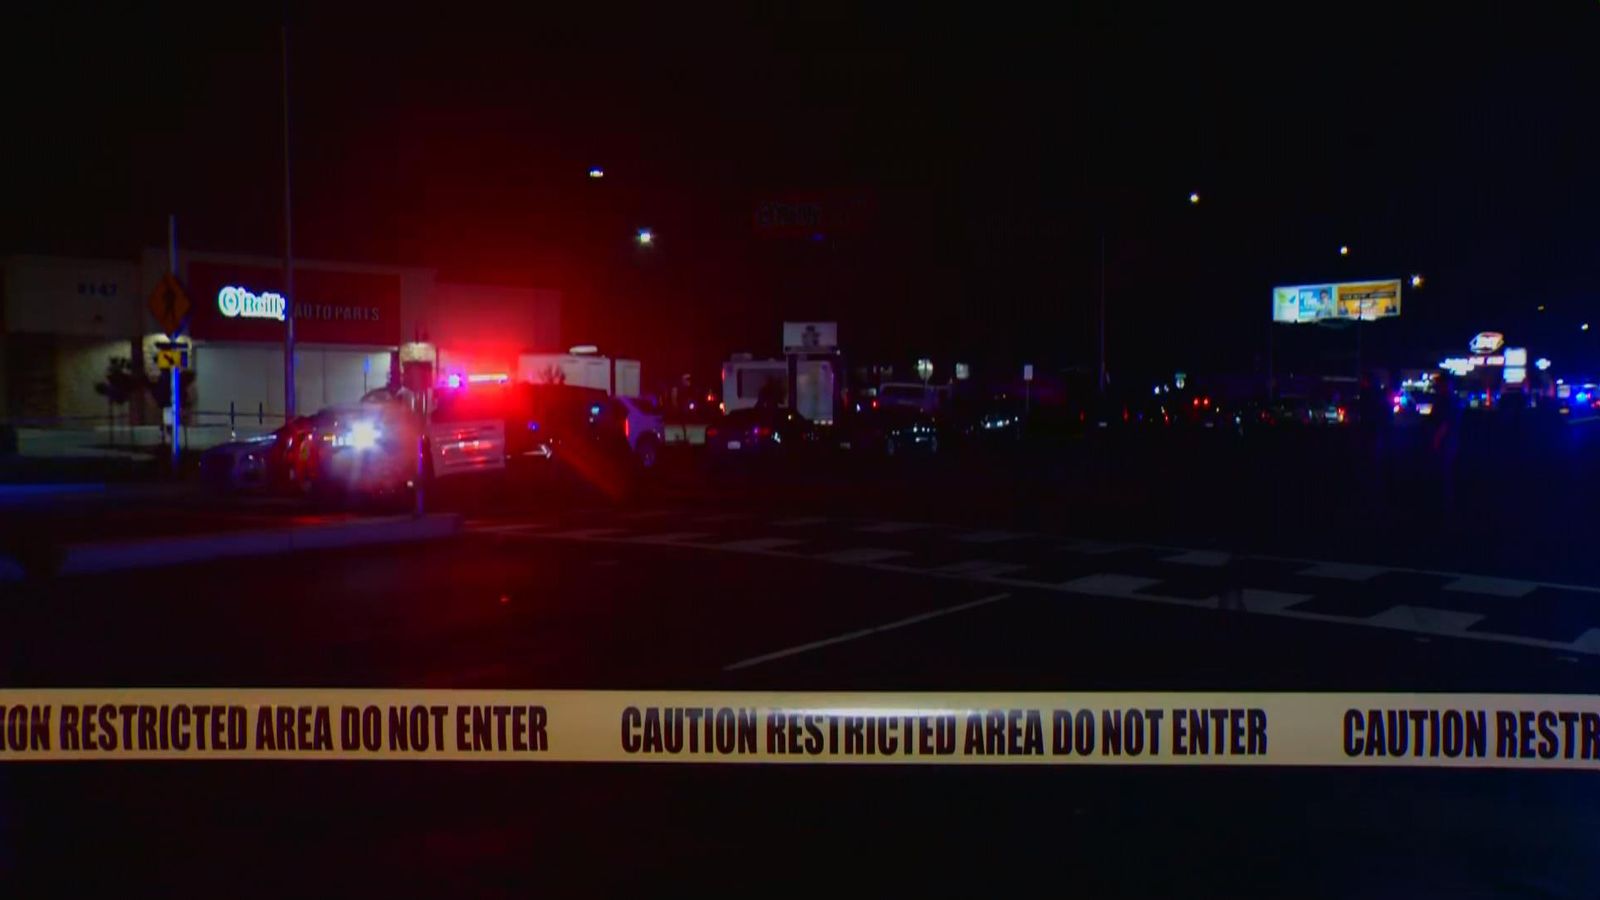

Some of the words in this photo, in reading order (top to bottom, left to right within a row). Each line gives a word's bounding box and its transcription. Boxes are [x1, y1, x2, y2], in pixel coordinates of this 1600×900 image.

[218, 286, 286, 321] O'Reilly
[293, 302, 332, 320] AUTO
[335, 306, 380, 321] PARTS
[59, 704, 248, 751] RESTRICTED
[255, 705, 334, 751] AREA
[341, 705, 382, 751] DO
[389, 705, 448, 751] NOT
[456, 706, 548, 751] ENTER
[621, 706, 757, 754] CAUTION
[766, 708, 956, 755] RESTRICTED
[963, 709, 1044, 755] AREA
[1052, 708, 1095, 756] DO
[1102, 708, 1163, 756] NOT
[1172, 709, 1267, 755] ENTER
[1343, 709, 1487, 757] CAUTION
[1496, 710, 1600, 760] RESTR
